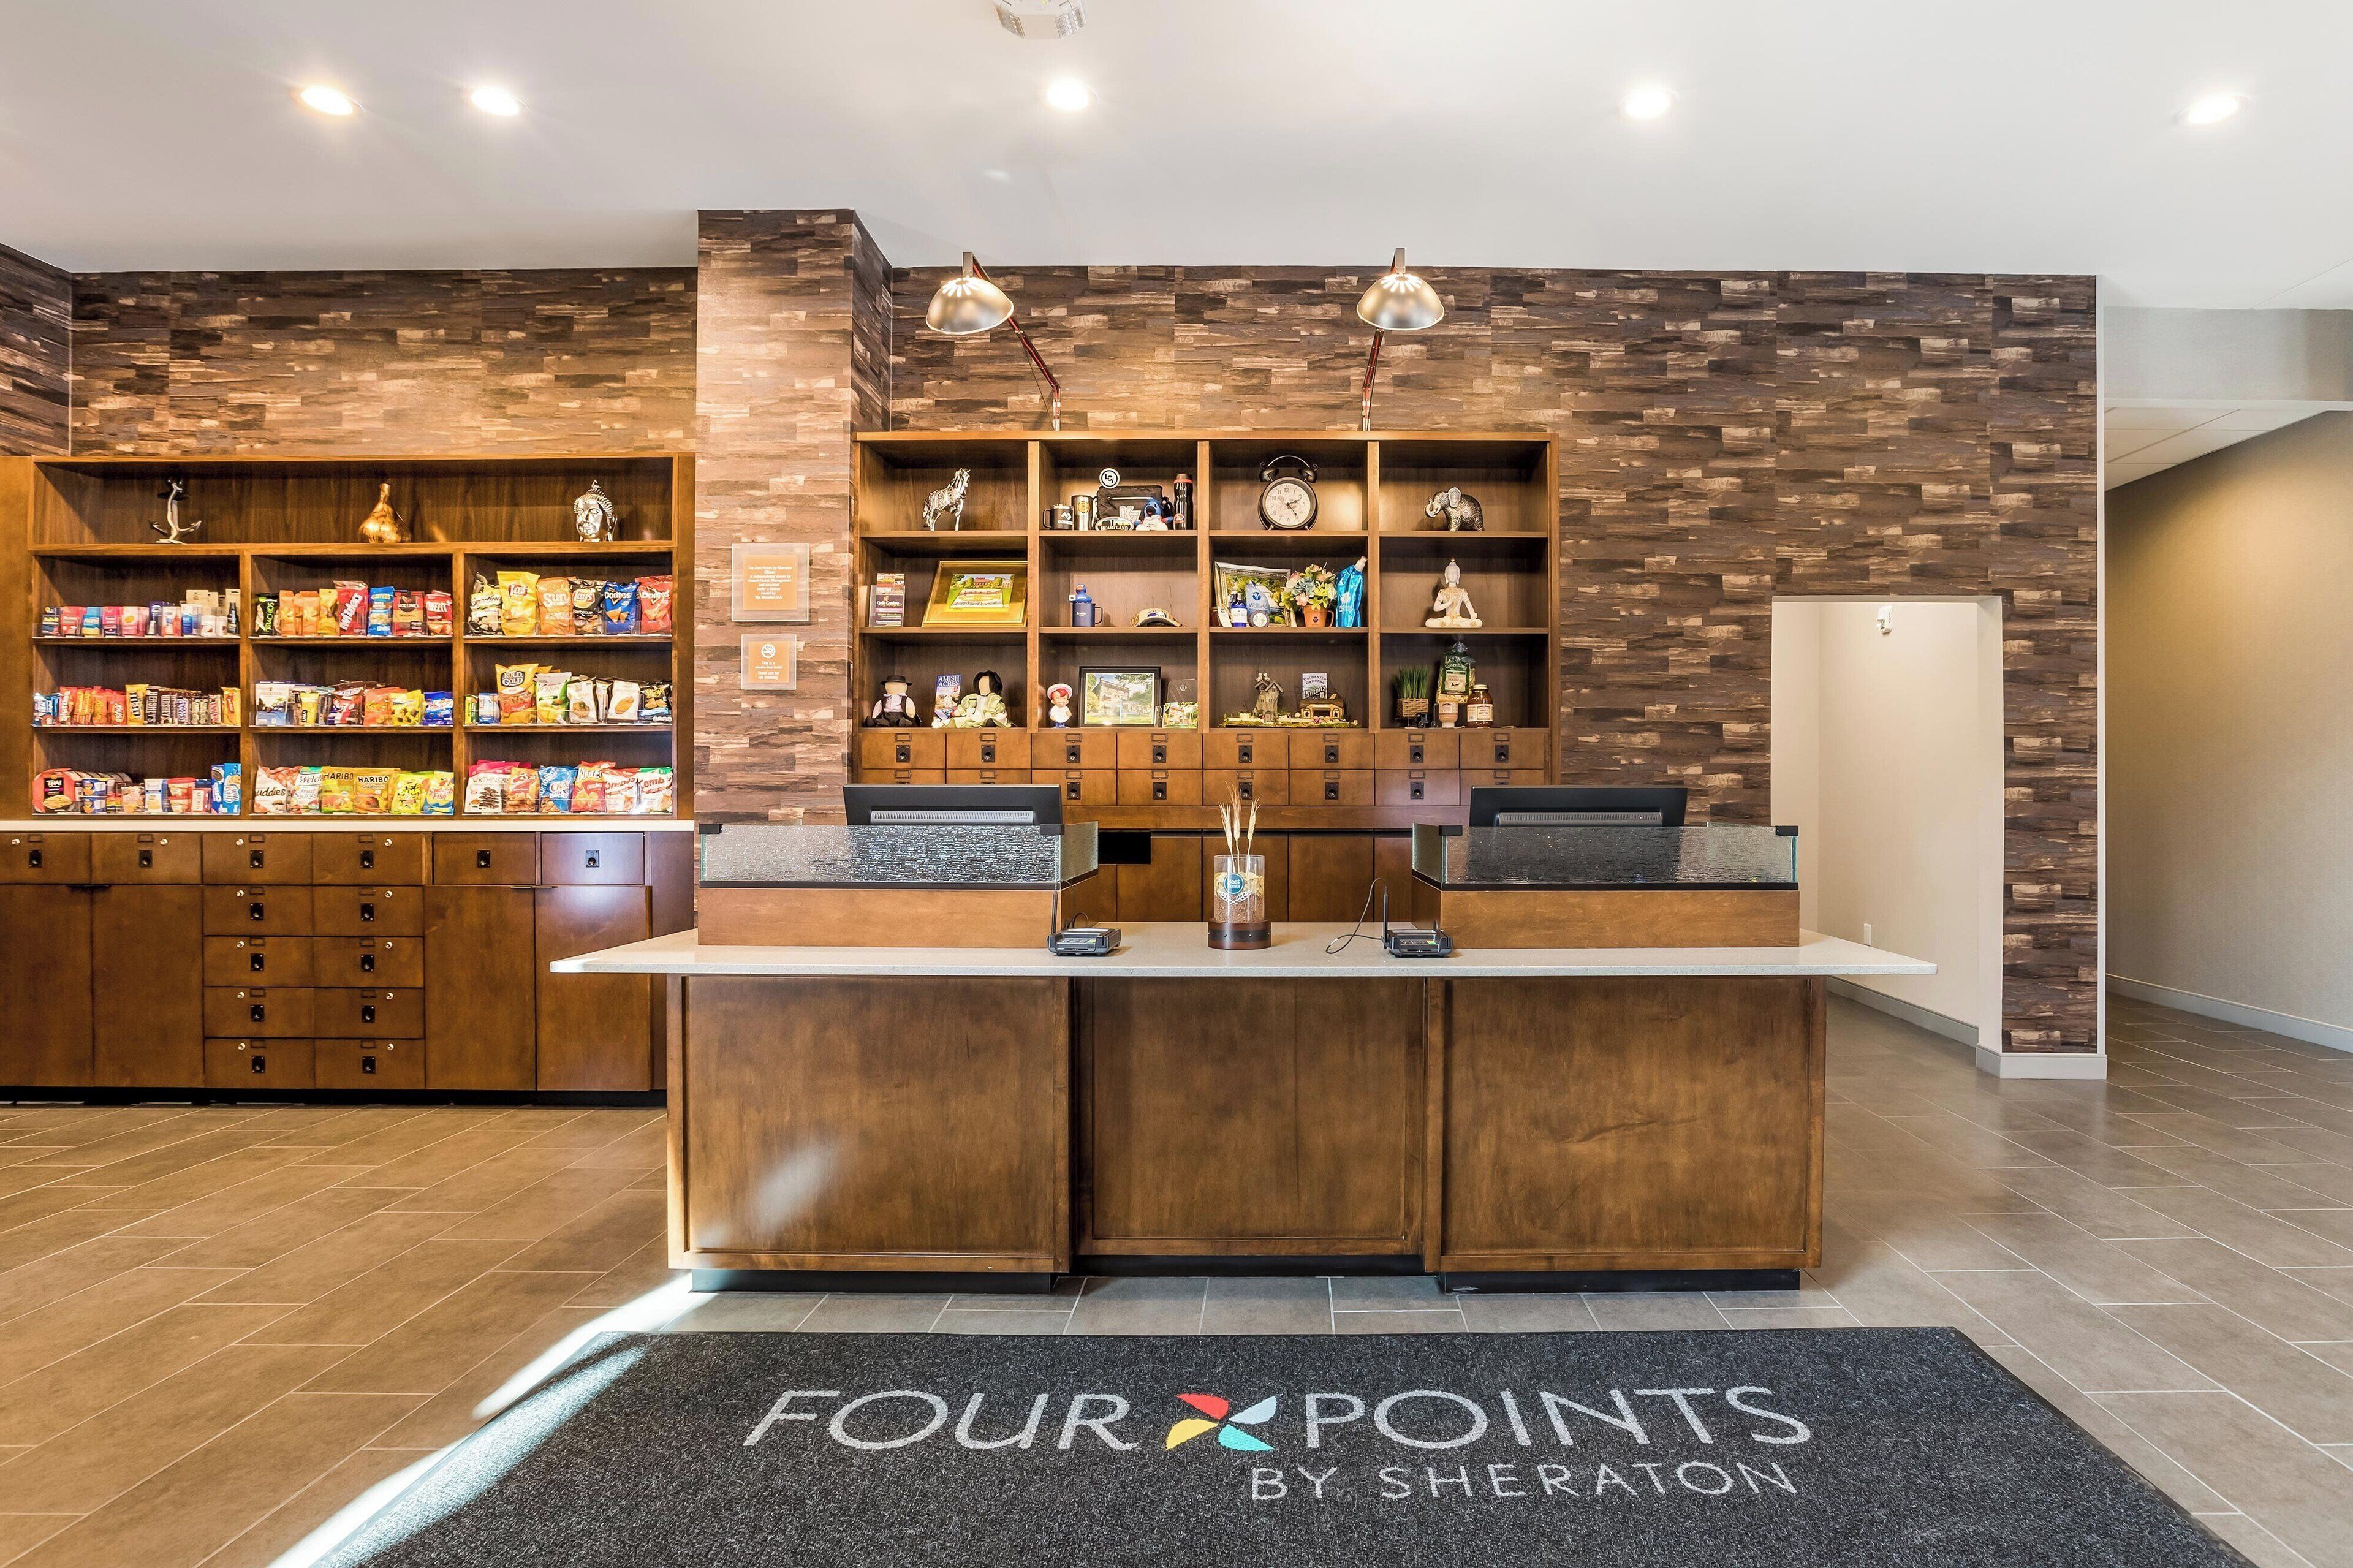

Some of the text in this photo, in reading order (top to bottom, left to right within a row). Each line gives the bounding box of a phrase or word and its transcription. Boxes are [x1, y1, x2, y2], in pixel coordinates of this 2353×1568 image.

[256, 787, 286, 797] uddies
[744, 1385, 1811, 1450] FOUR POINTS
[1251, 1461, 1797, 1499] BY SHERATON
